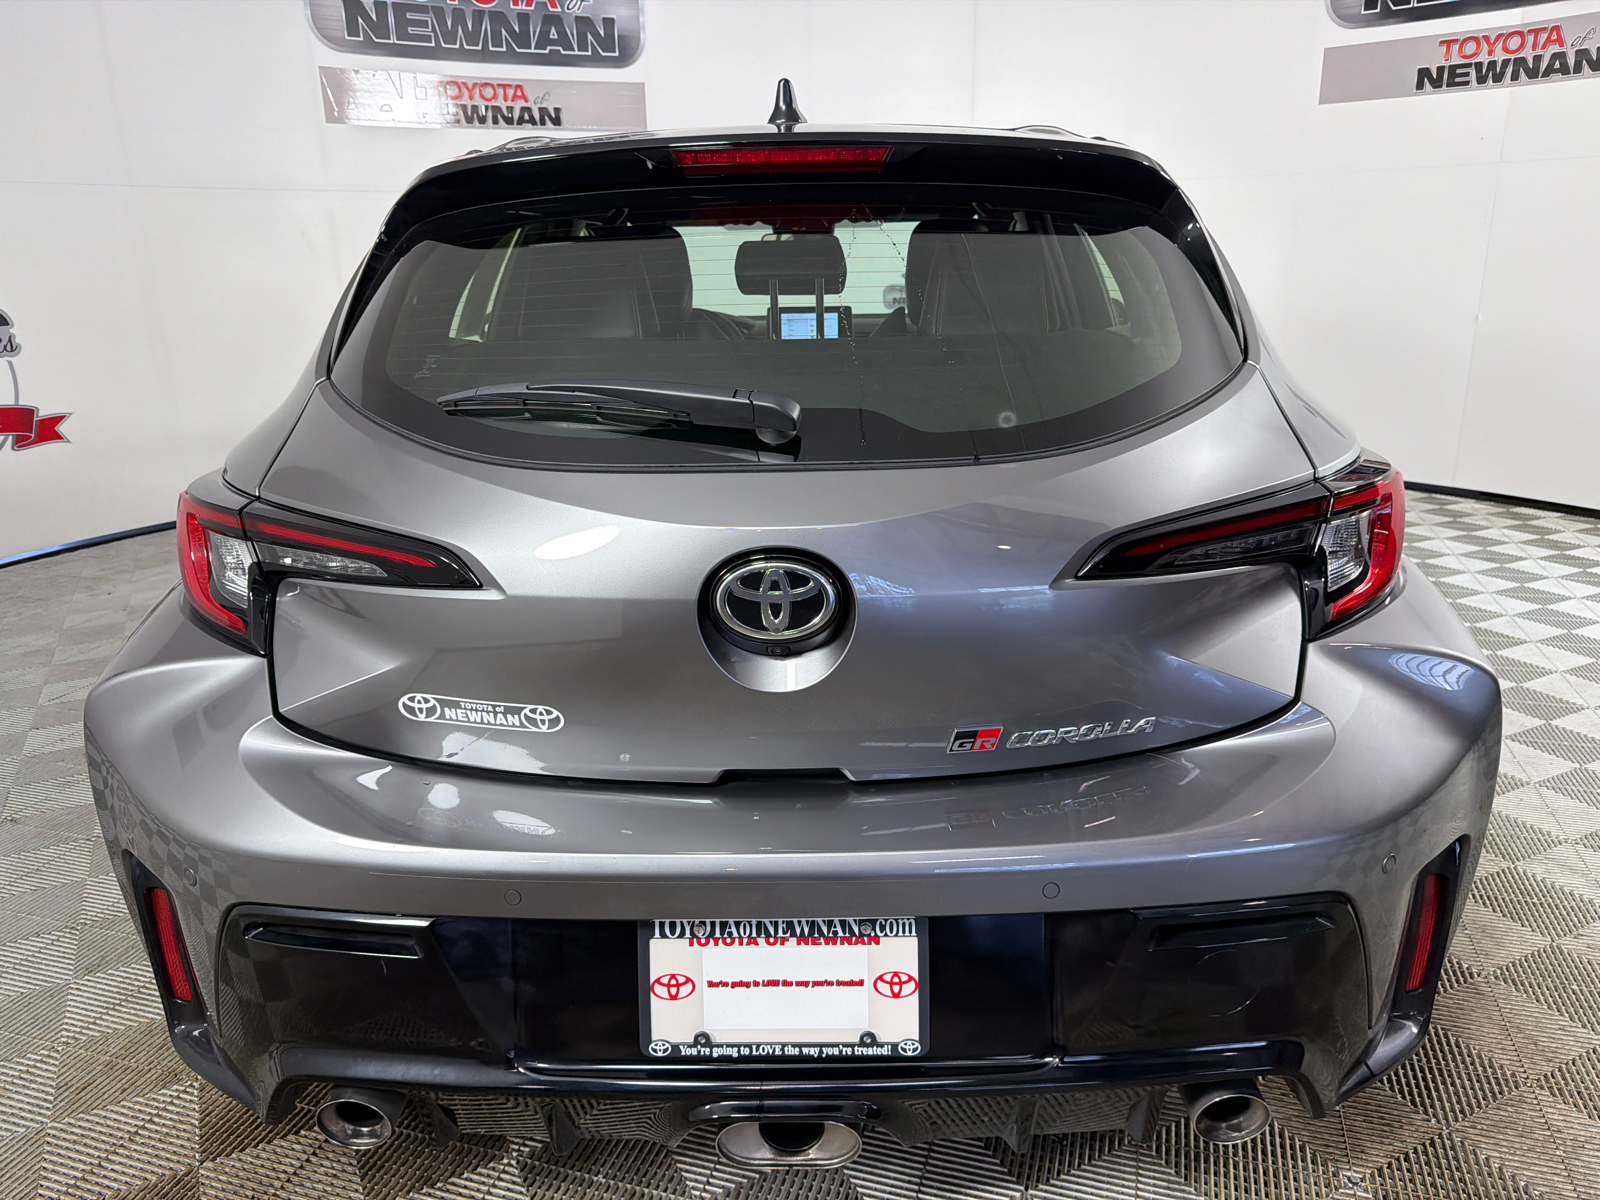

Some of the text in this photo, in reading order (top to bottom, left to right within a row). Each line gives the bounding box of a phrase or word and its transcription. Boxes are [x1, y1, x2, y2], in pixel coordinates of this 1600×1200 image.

[344, 0, 619, 56] NEWNAN
[1438, 24, 1596, 62] TOYOTA of
[1414, 45, 1600, 93] NEWNAN
[444, 707, 520, 726] NEWNAN
[459, 702, 493, 712] TOYOTA
[1005, 716, 1157, 749] COROLLA
[730, 980, 751, 989] going
[761, 979, 781, 987] LOVE
[781, 979, 794, 987] the
[795, 980, 811, 988] way
[679, 1045, 892, 1058] You're going to LOVE the way you're treated!
